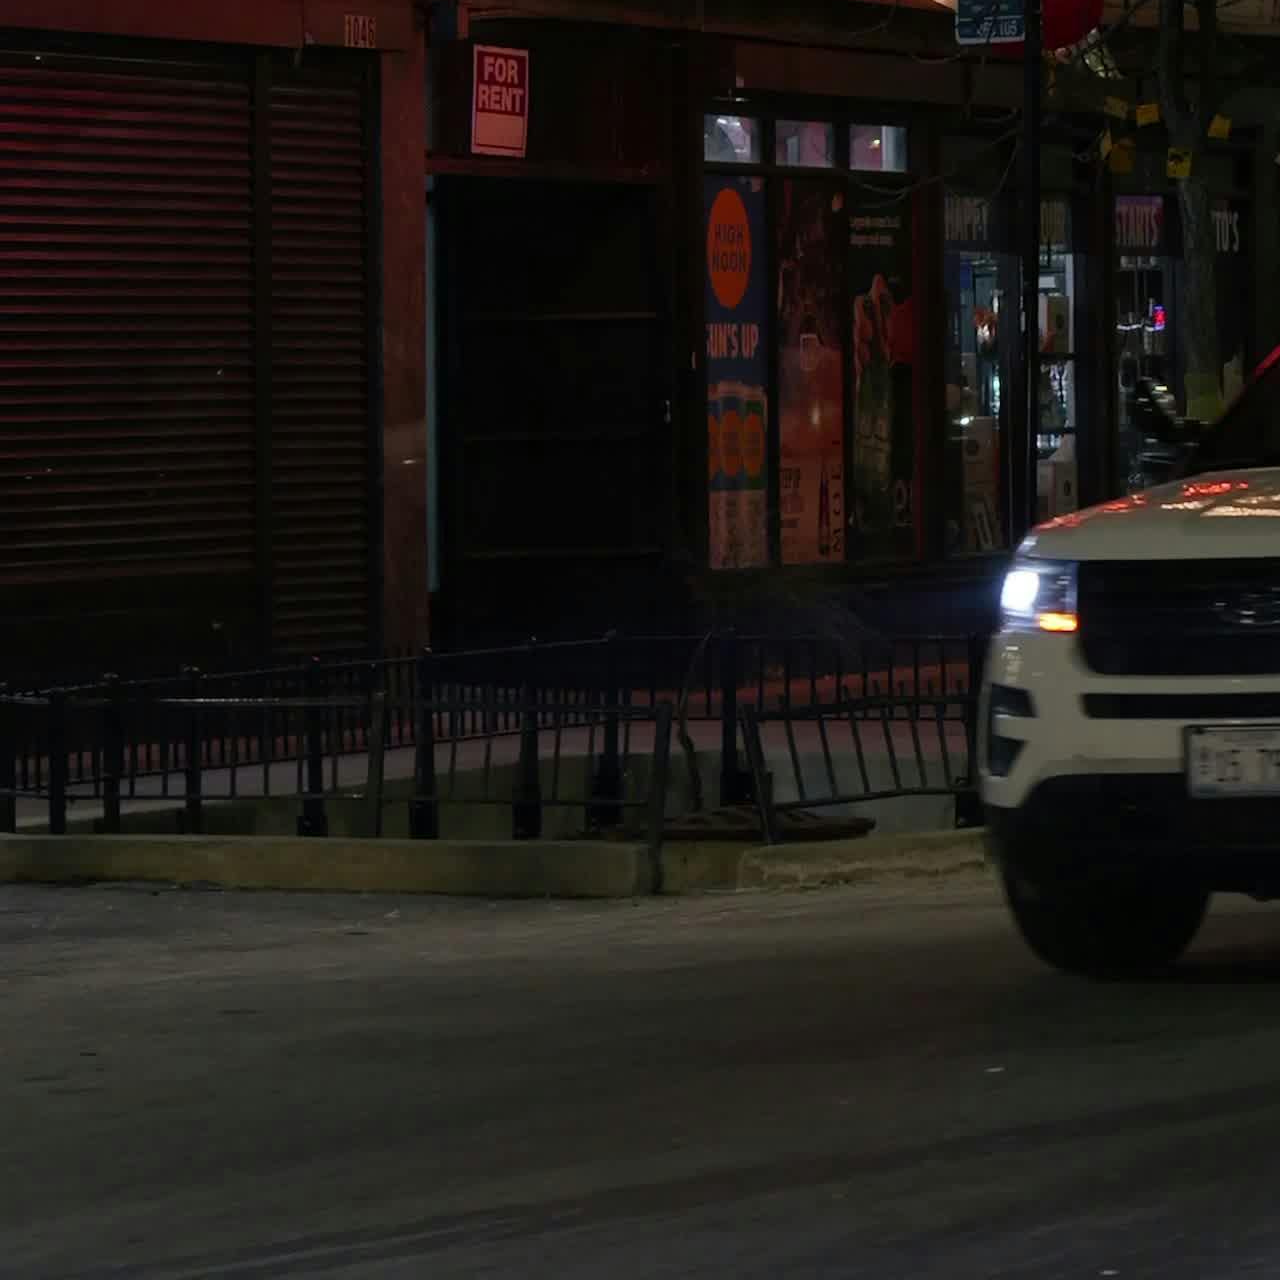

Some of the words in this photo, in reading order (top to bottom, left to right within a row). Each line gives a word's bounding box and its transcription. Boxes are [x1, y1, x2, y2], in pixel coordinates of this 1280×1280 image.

[482, 56, 519, 86] FOR
[477, 83, 525, 113] RENT
[741, 322, 760, 360] UP
